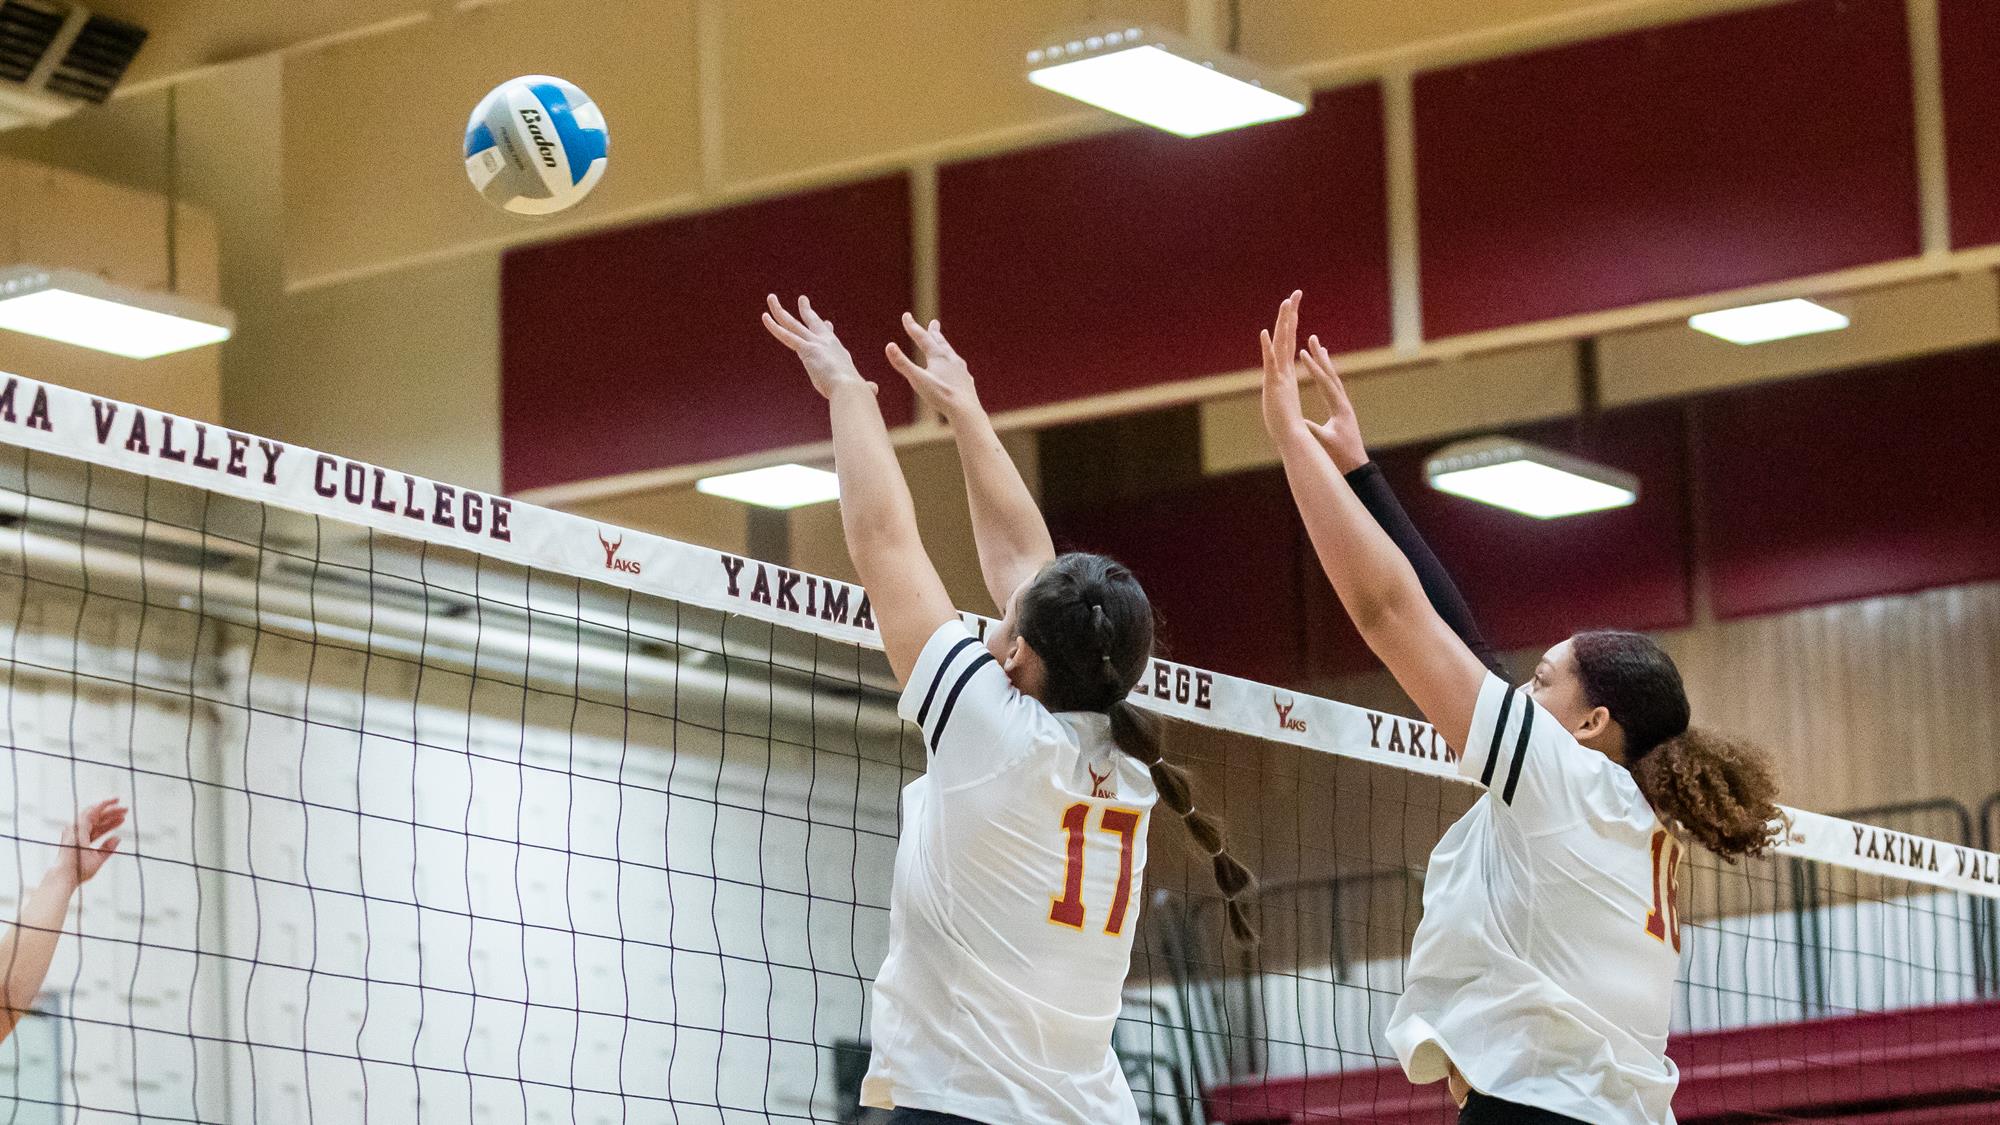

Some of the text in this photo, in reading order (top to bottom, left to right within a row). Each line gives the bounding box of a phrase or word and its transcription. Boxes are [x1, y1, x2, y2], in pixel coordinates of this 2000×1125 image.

[518, 109, 557, 168] Baden
[91, 398, 285, 485] VALLEY
[314, 454, 512, 543] COLLEGE
[598, 527, 641, 575] YAKS
[720, 554, 875, 630] YAKIMA
[1273, 691, 1307, 732] YAKS
[1047, 802, 1142, 936] 17
[1853, 826, 1939, 872] YAKIMA
[1954, 847, 2000, 885] VAL
